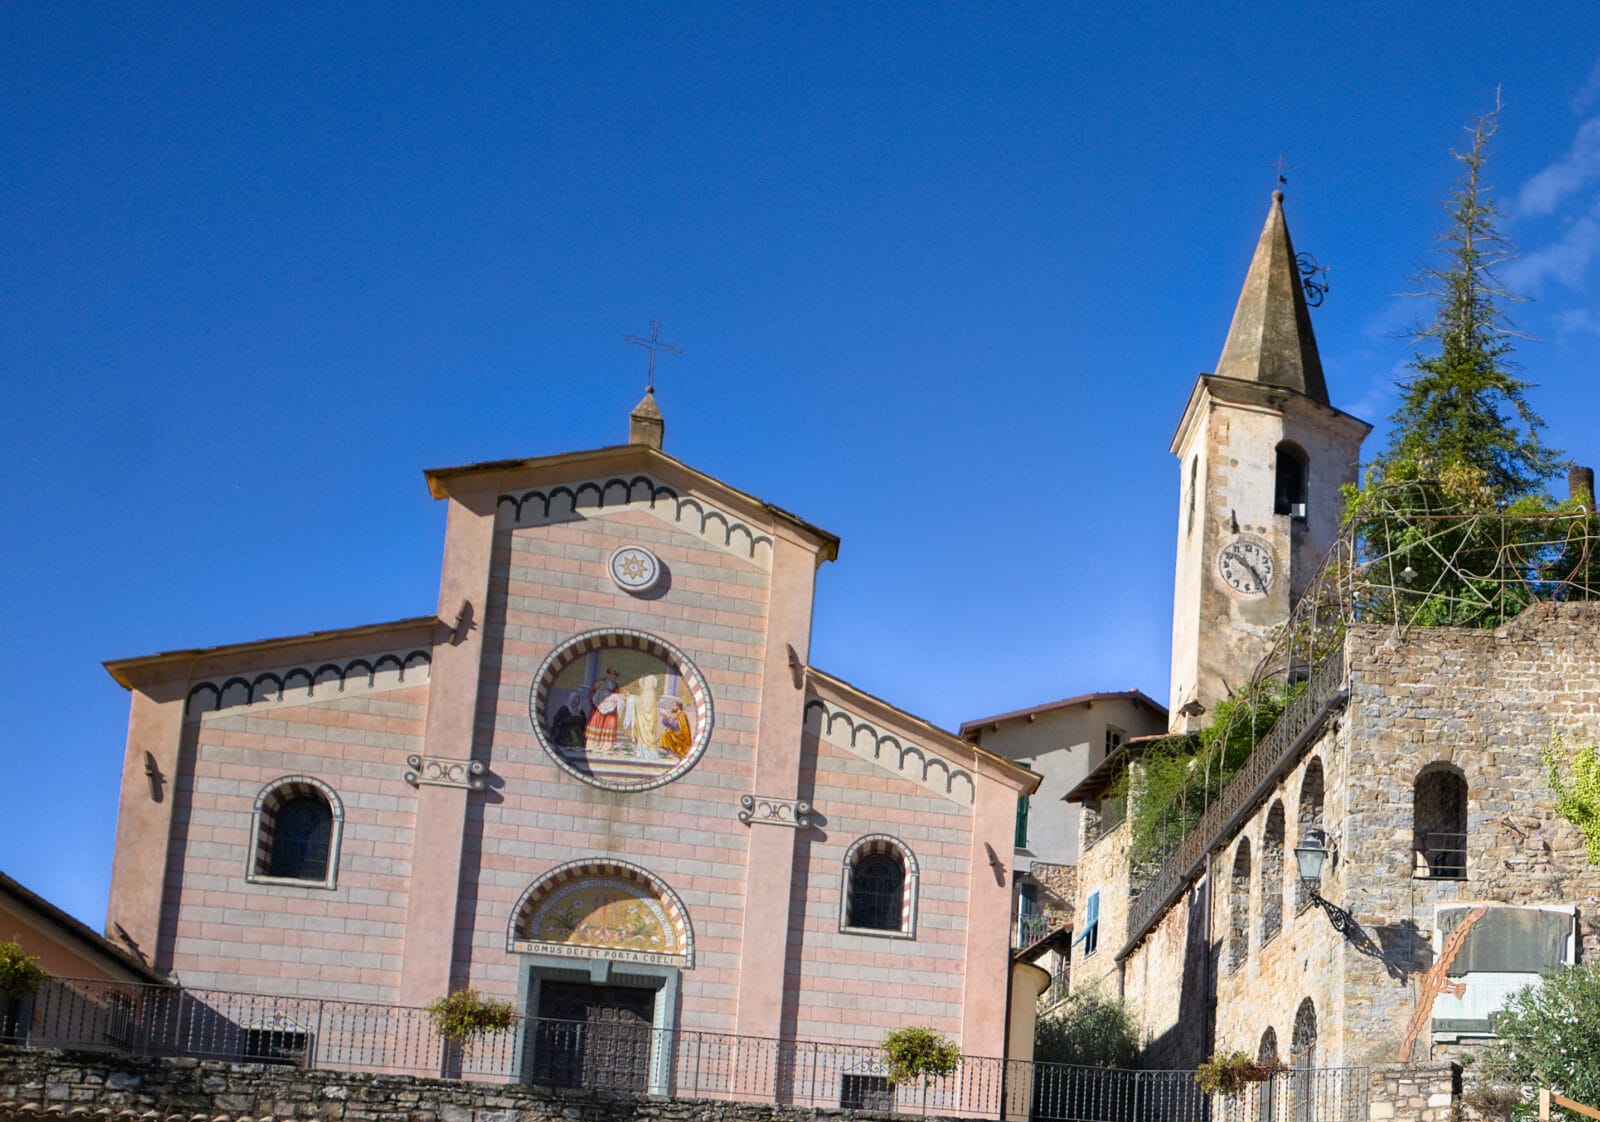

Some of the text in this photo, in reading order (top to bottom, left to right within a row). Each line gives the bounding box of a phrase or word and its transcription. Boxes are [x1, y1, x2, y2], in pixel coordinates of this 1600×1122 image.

[526, 943, 674, 964] DOMUS DEI ET PORTA COELI
